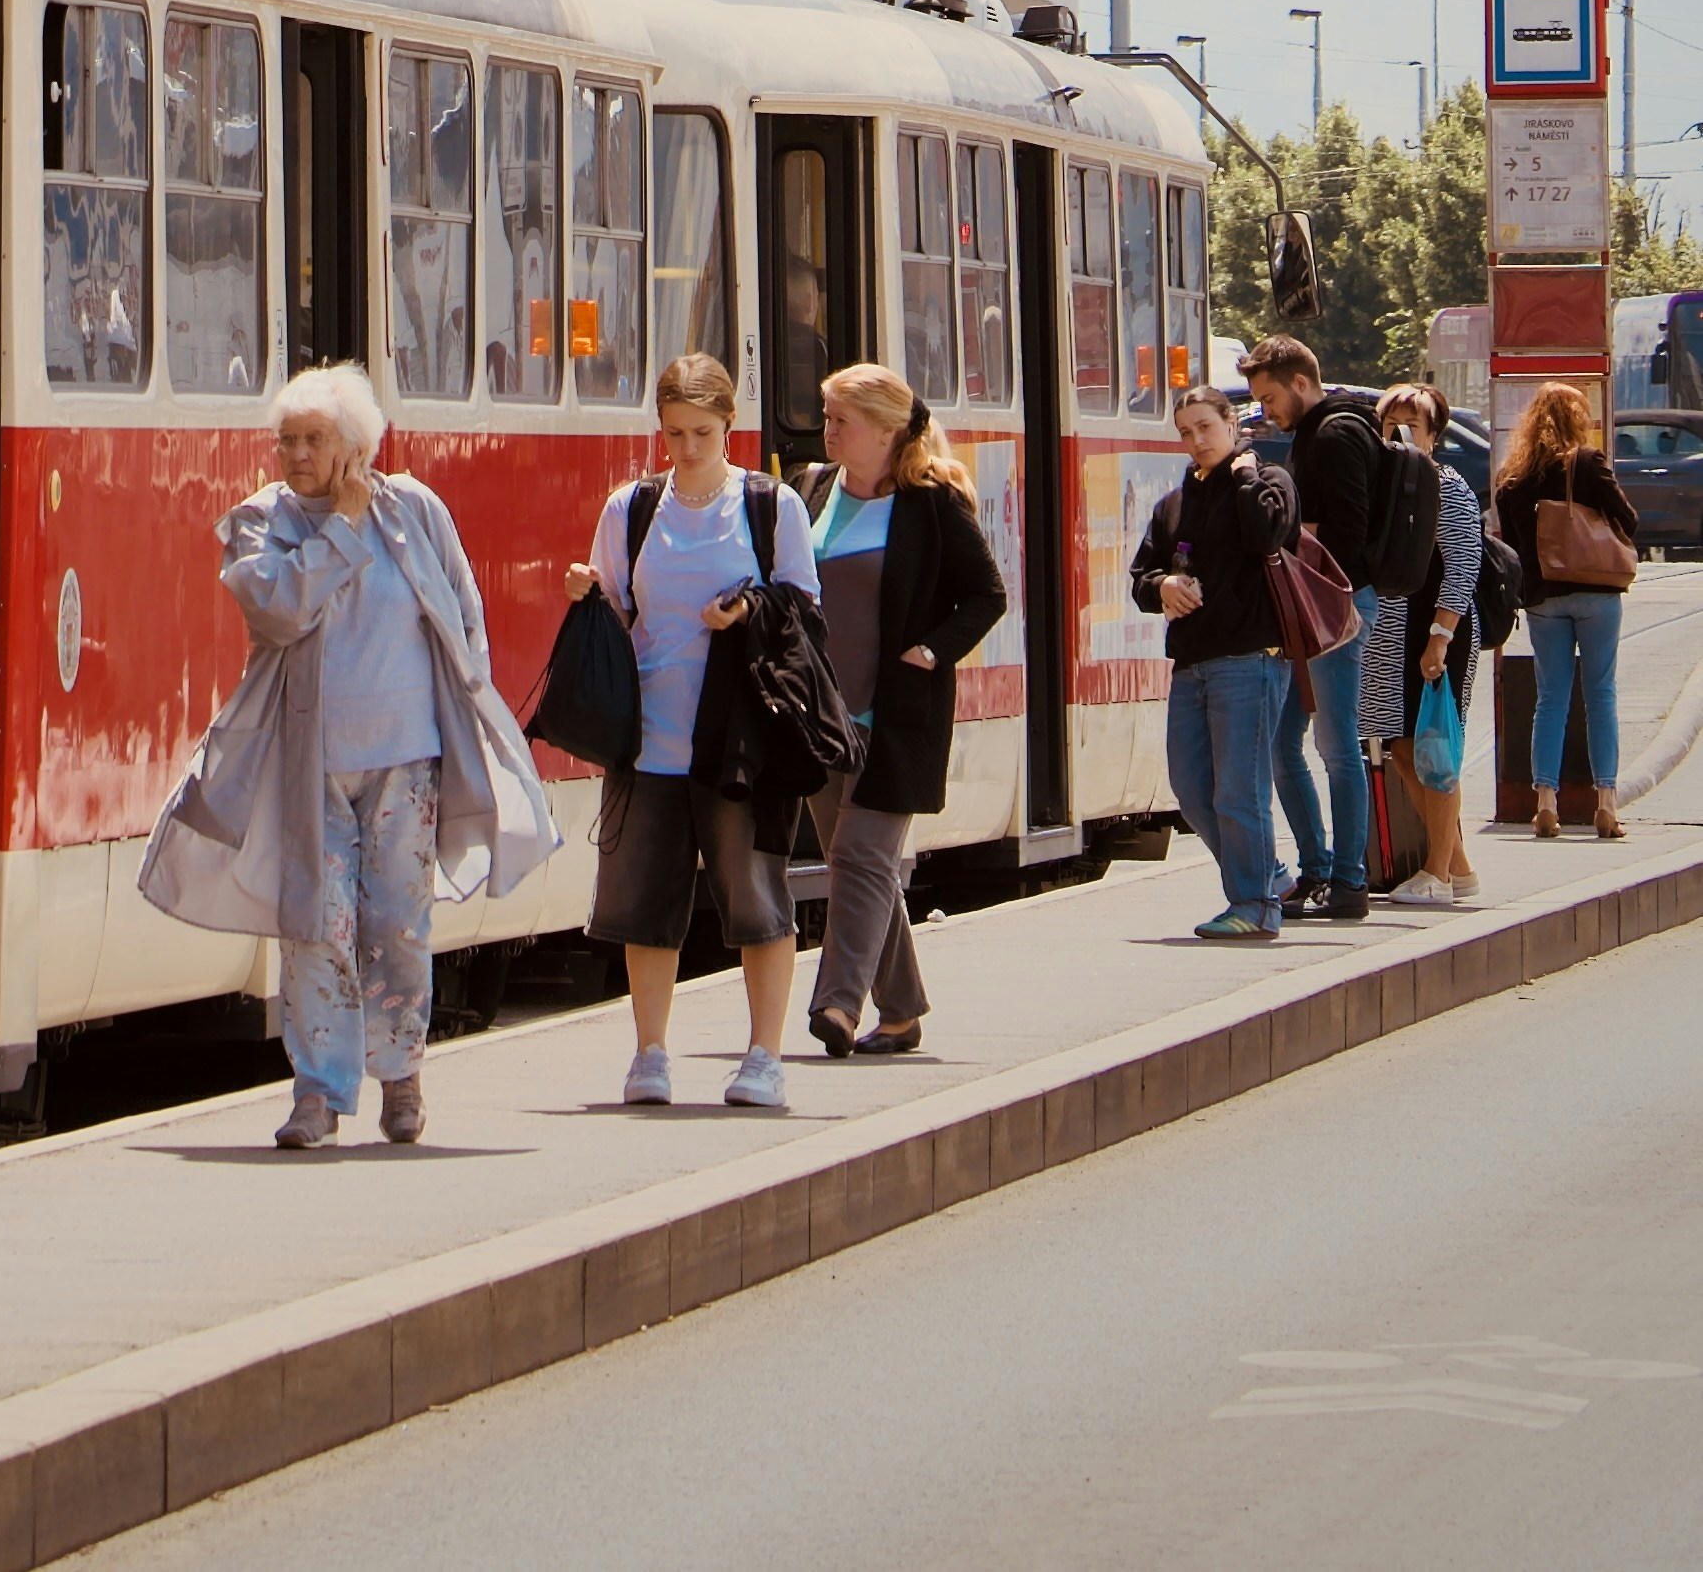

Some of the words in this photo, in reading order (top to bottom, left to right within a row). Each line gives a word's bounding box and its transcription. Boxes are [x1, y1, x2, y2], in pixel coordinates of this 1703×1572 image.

[1523, 118, 1574, 129] JIRÁSKOVO
[1528, 129, 1570, 141] NÁMĚSTÍ
[1532, 156, 1541, 171] 5
[1528, 187, 1546, 201] 17
[1551, 187, 1571, 201] 27
